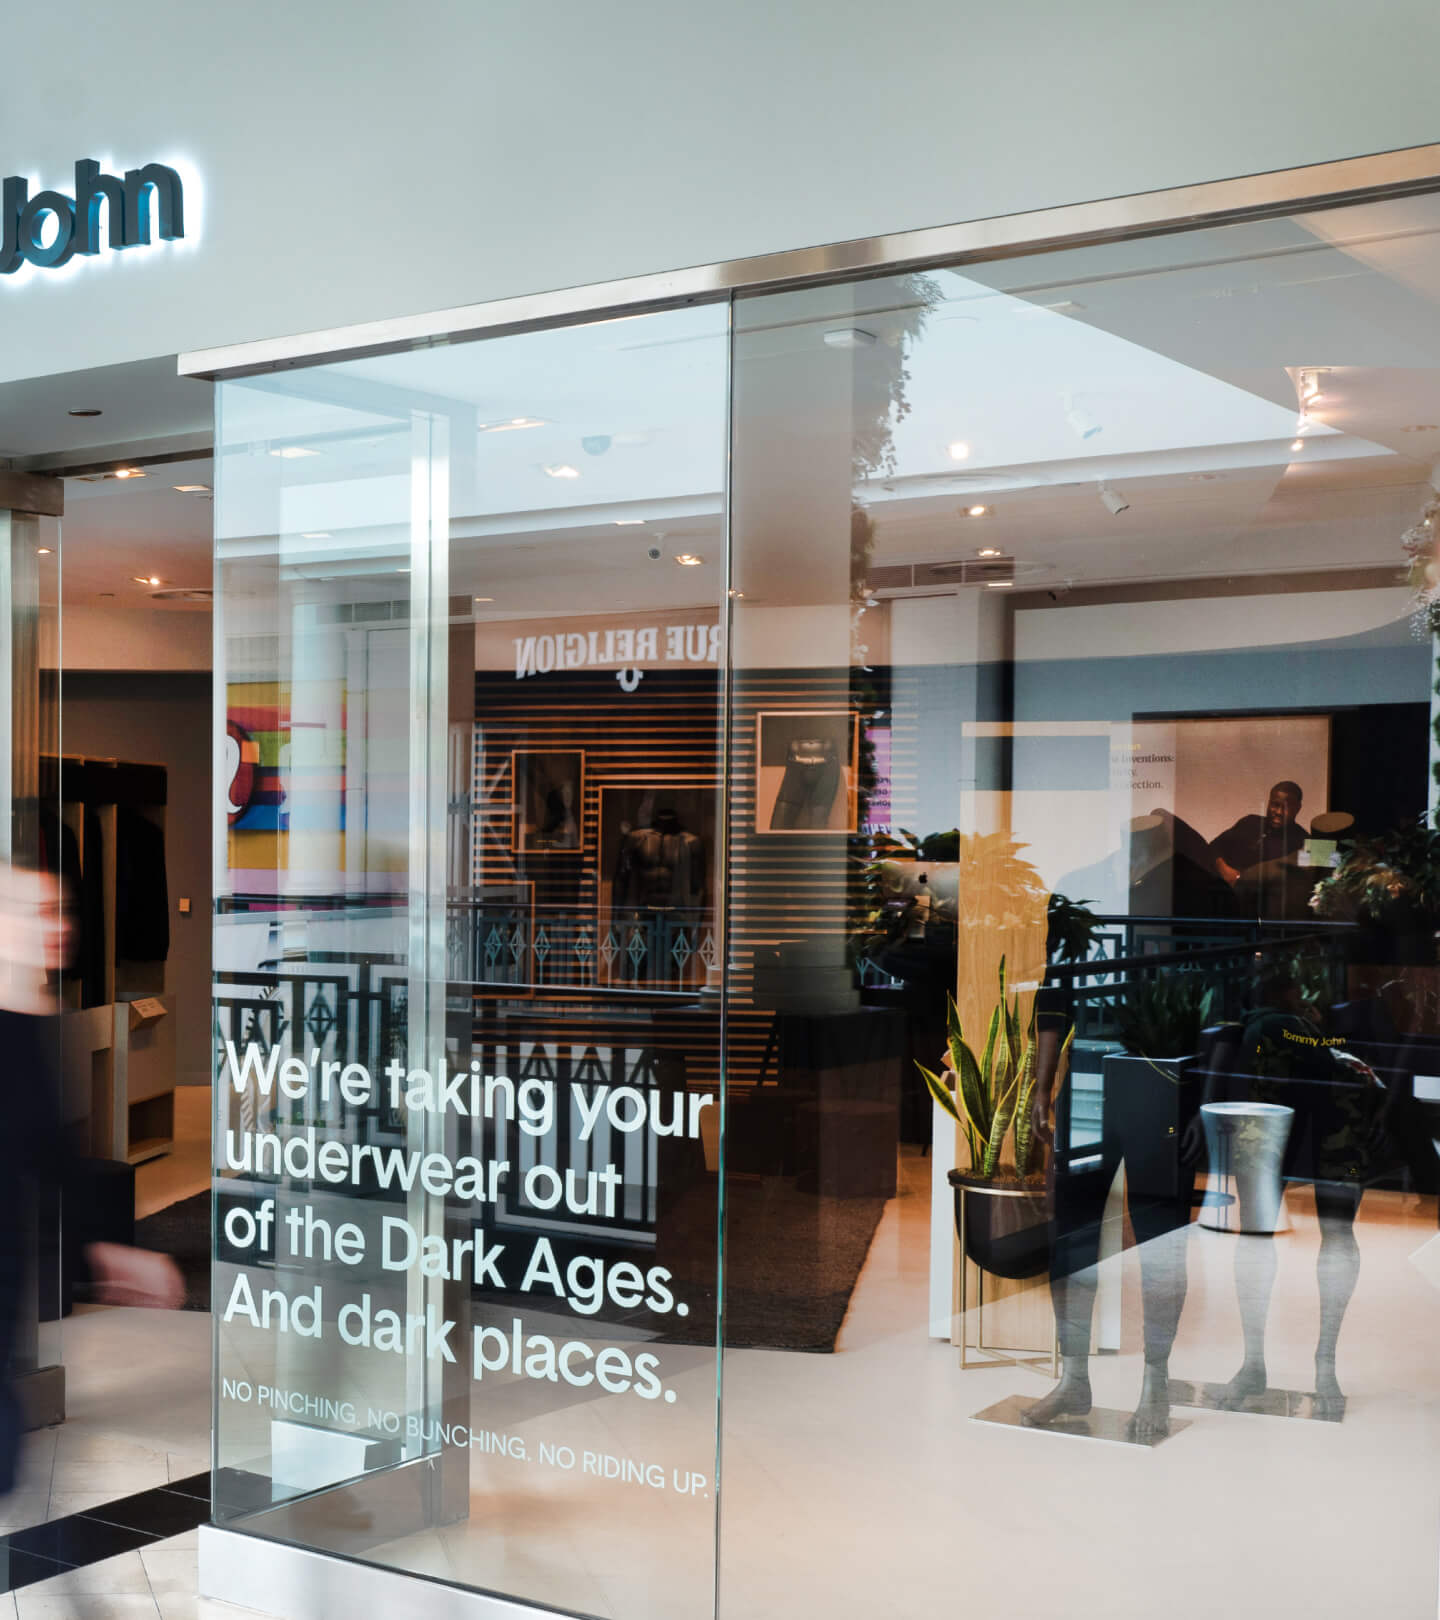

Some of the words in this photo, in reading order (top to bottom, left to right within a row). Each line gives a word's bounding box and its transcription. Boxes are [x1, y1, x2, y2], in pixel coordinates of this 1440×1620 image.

[1282, 1029, 1320, 1047] Tommy
[1320, 1036, 1347, 1047] John
[385, 1059, 554, 1137] taking
[571, 1082, 714, 1141] your
[226, 1127, 510, 1203] underwear
[524, 1162, 623, 1218] out
[224, 1199, 275, 1250] of
[285, 1205, 366, 1266] the
[381, 1215, 506, 1289] Dark
[520, 1236, 690, 1317] Ages.
[223, 1272, 322, 1339] And
[337, 1293, 458, 1364] dark
[472, 1317, 678, 1404] places.
[222, 1378, 252, 1404] NO
[258, 1386, 362, 1427] PINCHING.
[368, 1408, 401, 1435] NO
[406, 1415, 532, 1463] BUNCHING.
[540, 1442, 576, 1470] NO
[583, 1452, 666, 1490] RIDING
[673, 1469, 710, 1499] UP.
